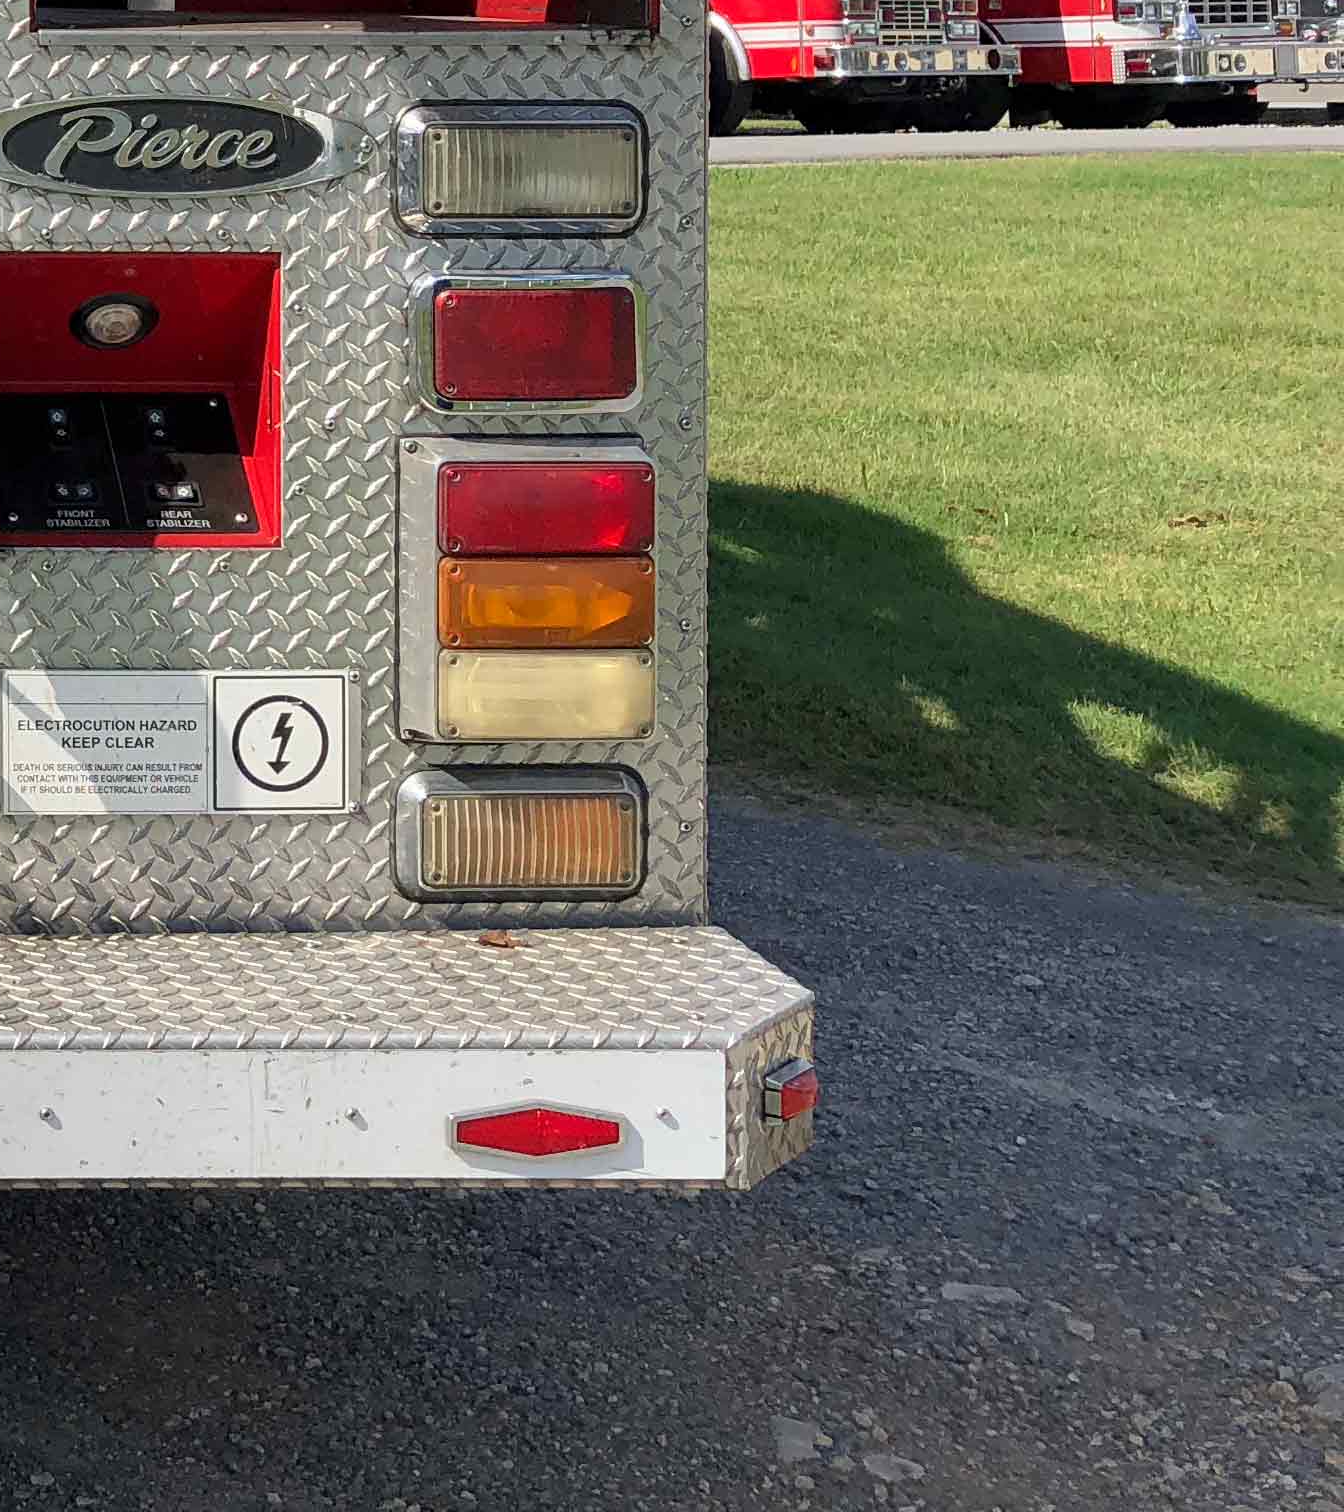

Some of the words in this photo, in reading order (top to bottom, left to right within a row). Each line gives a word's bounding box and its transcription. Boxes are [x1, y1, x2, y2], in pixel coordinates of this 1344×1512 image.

[44, 107, 278, 178] Pierce
[56, 509, 96, 518] FRONT
[160, 510, 192, 519] REAR
[46, 519, 111, 528] STABILIZER
[146, 519, 212, 528] STABILIZER
[17, 720, 135, 731] ELECTROCUTION
[140, 720, 198, 731] HAZARD
[62, 737, 101, 749] KEEP
[105, 737, 155, 749] CLEAR
[12, 763, 40, 772] DEATH
[43, 763, 54, 772] OR
[57, 763, 93, 772] SERIOUS
[94, 763, 124, 772] INJURY
[126, 763, 143, 772] CAN
[145, 763, 177, 772] RESULT
[179, 763, 203, 772] FROM
[17, 774, 56, 783] CONTACT
[58, 774, 78, 783] WITH
[80, 774, 98, 783] THIS
[100, 774, 148, 783] EQUIPMENT
[150, 774, 162, 783] OR
[164, 774, 199, 783] VEHICLE
[39, 785, 73, 794] SHOULD
[75, 785, 86, 794] BE
[88, 785, 148, 794] ELECTRICALLY
